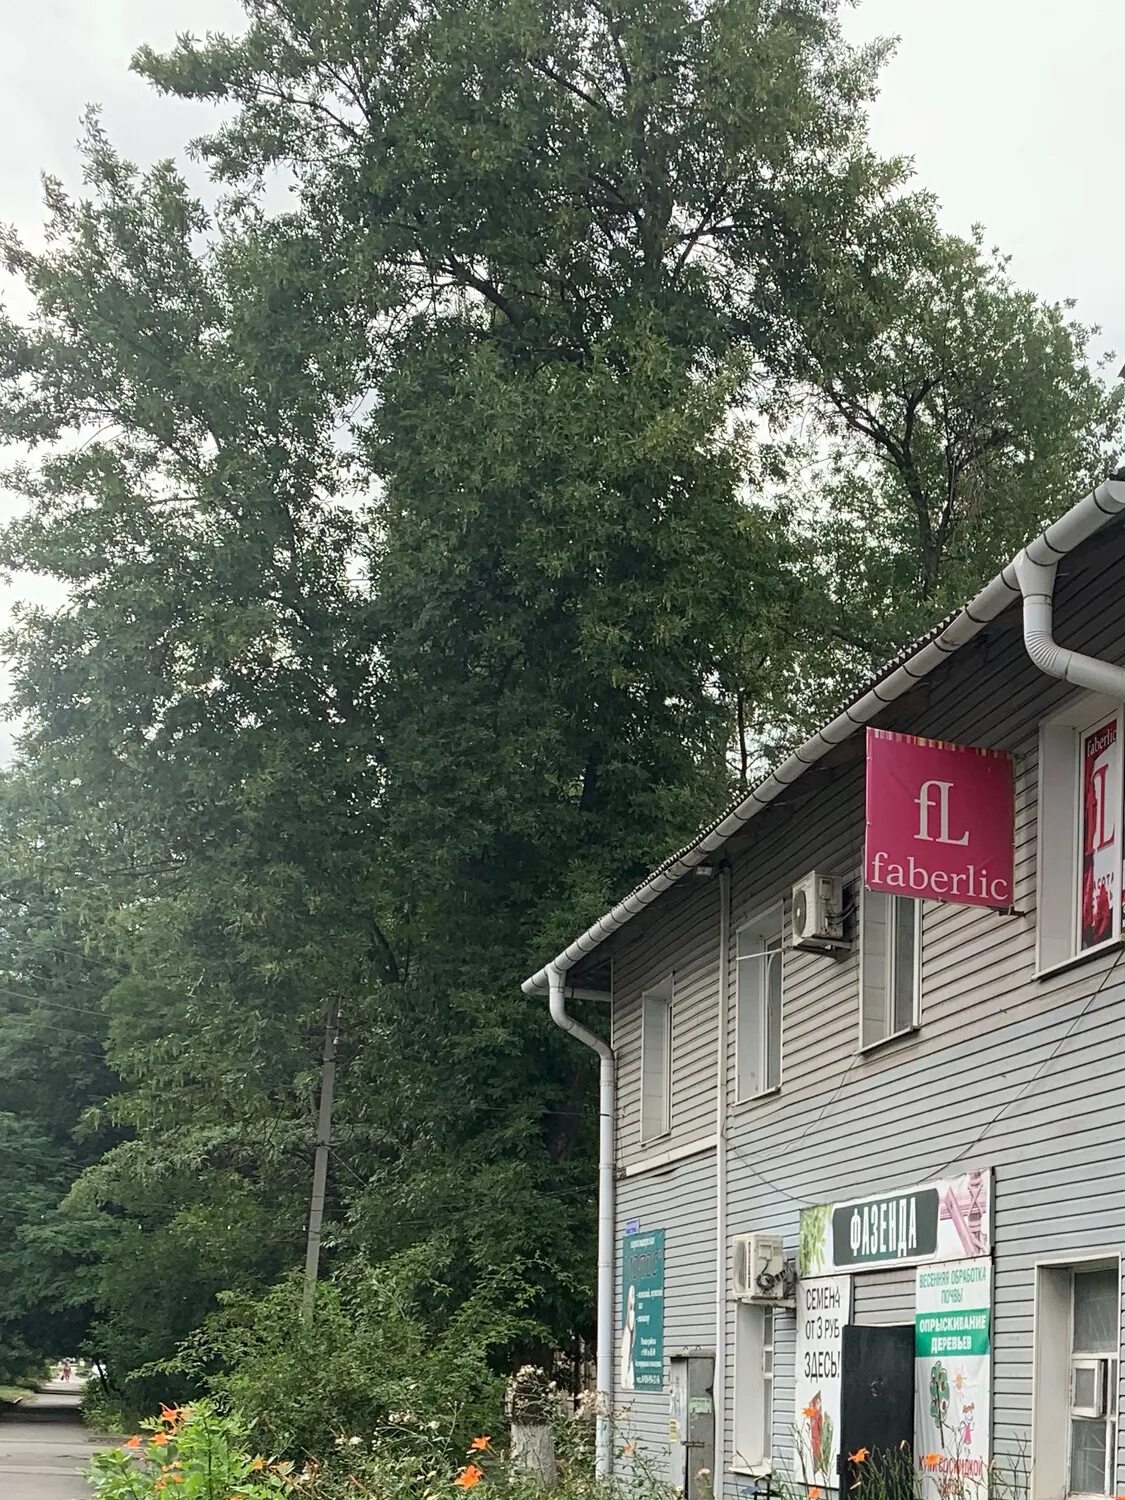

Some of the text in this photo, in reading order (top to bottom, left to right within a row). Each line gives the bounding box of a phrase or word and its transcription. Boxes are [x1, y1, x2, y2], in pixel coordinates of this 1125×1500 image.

[1087, 729, 1117, 757] faberlic
[913, 780, 970, 846] fL
[871, 851, 1008, 901] faberlic
[850, 1196, 917, 1257] ФАЗЕНДА
[920, 1266, 987, 1288] ВЕСЕННЯЯ ОБРАБОТКА
[806, 1286, 840, 1311] СЕМЕНА
[941, 1288, 964, 1304] ПОЧВЫ
[817, 1316, 823, 1340] 3
[824, 1318, 841, 1339] РУБ
[920, 1315, 987, 1333] ОПРЫСКИВАНИЕ
[931, 1335, 972, 1354] ДЕРЕВЬЕВ
[804, 1351, 841, 1383] ЗДЕСЬ!
